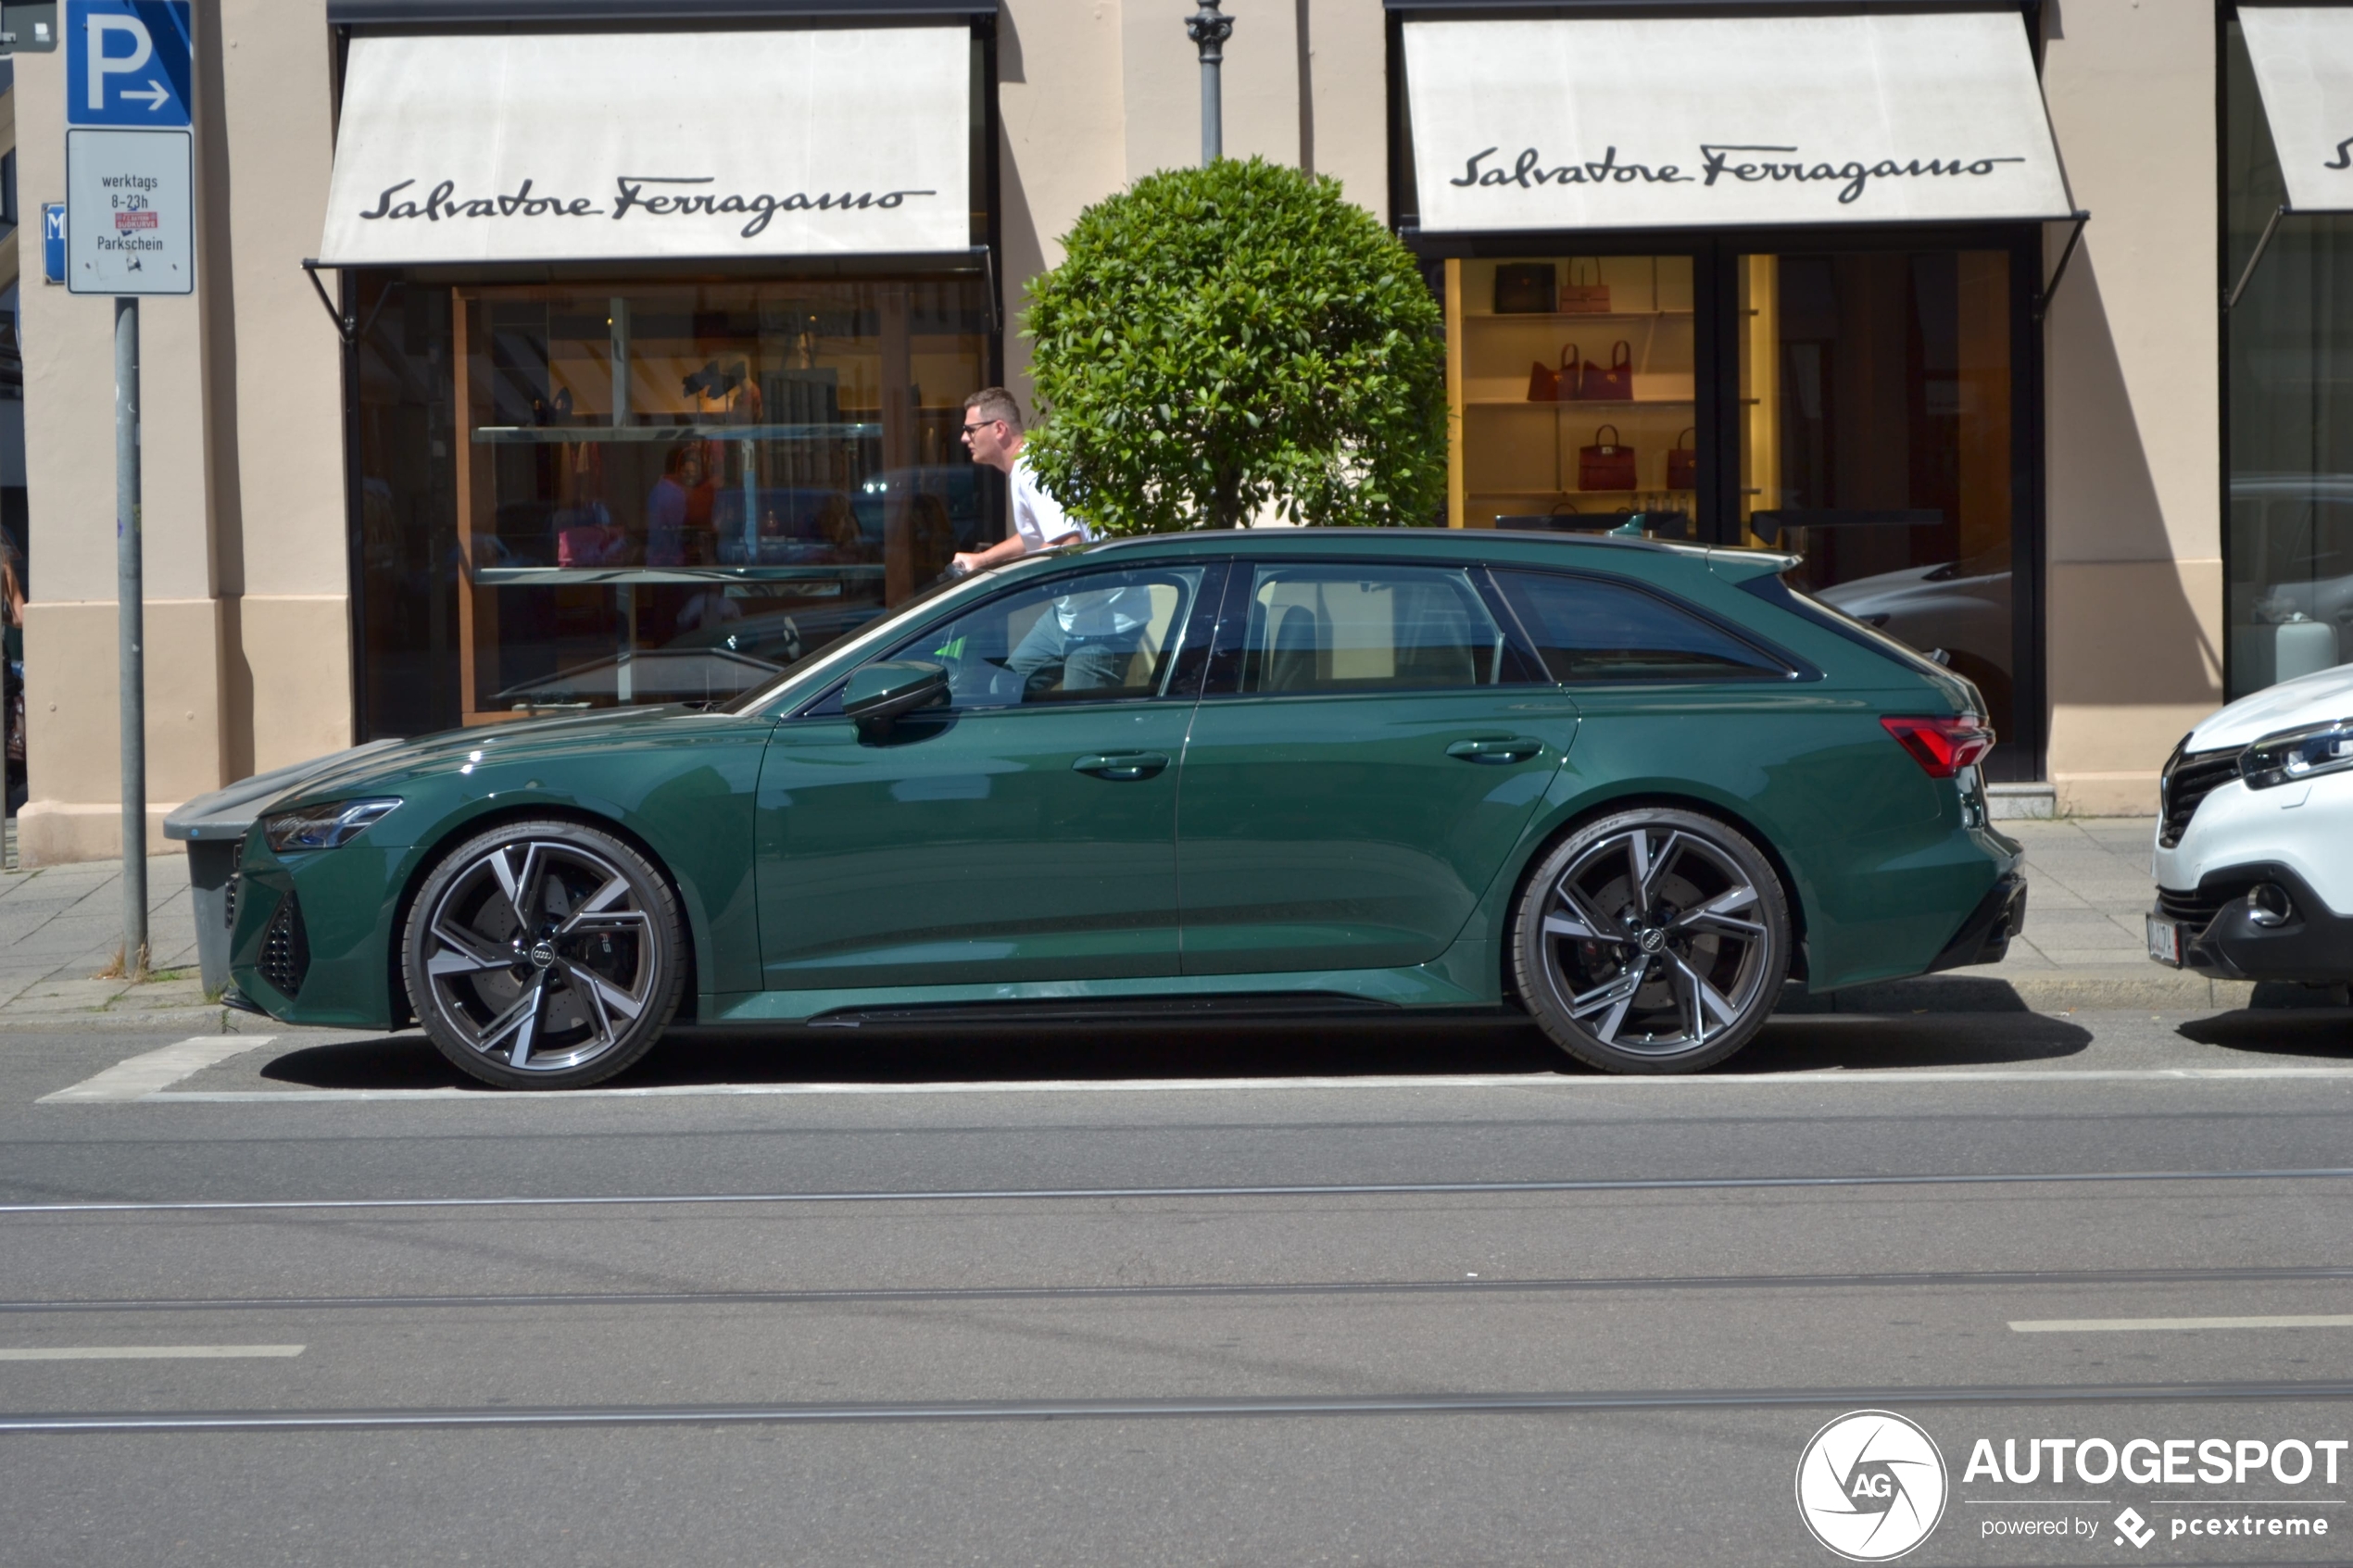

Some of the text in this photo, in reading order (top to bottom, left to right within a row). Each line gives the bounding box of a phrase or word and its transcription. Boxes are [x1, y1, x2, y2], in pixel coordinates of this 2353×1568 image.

[87, 14, 152, 109] P
[102, 174, 157, 192] werktags
[1449, 144, 2026, 205] Salvatore Ferragamo
[359, 176, 937, 239] Salvatore Ferragamo
[97, 235, 163, 250] Parkschein
